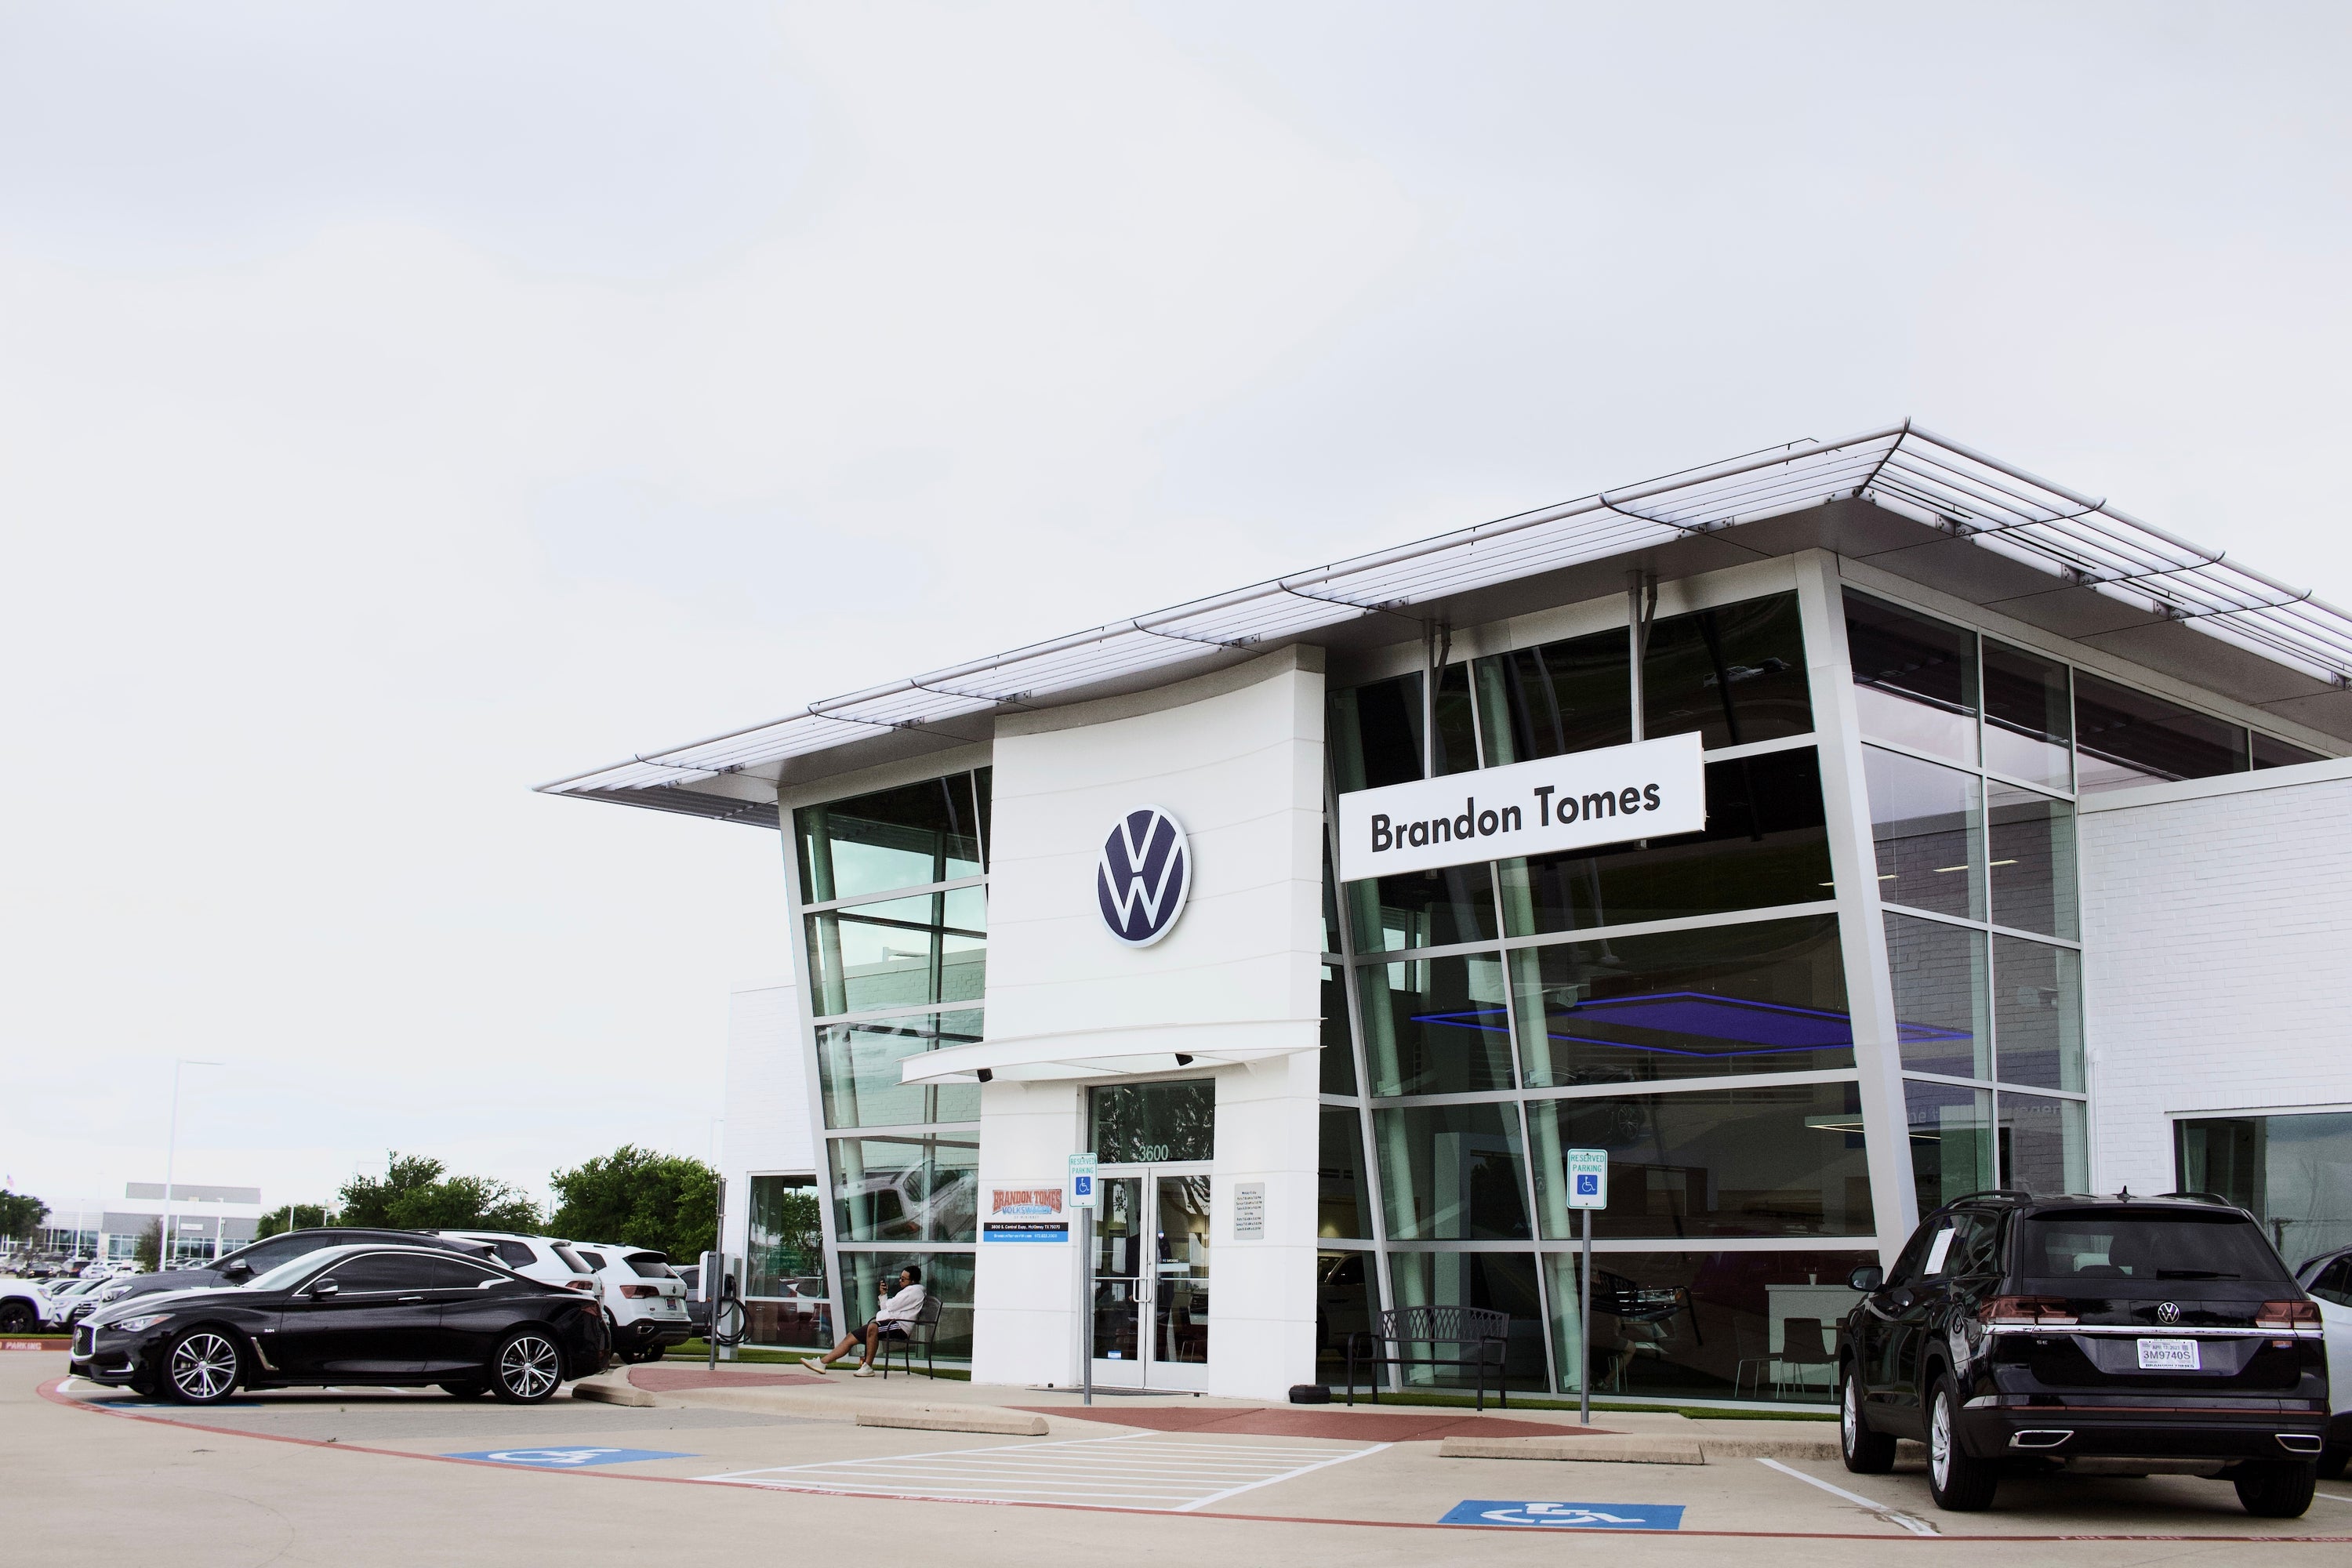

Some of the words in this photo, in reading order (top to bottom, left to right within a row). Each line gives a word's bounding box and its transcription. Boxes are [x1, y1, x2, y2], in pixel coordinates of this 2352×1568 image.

[1371, 797, 1521, 852] Brandon
[1534, 782, 1661, 826] Tomes
[1138, 1145, 1168, 1161] 3600
[5, 1341, 42, 1350] PARKING
[2143, 1351, 2190, 1359] 3M9740S
